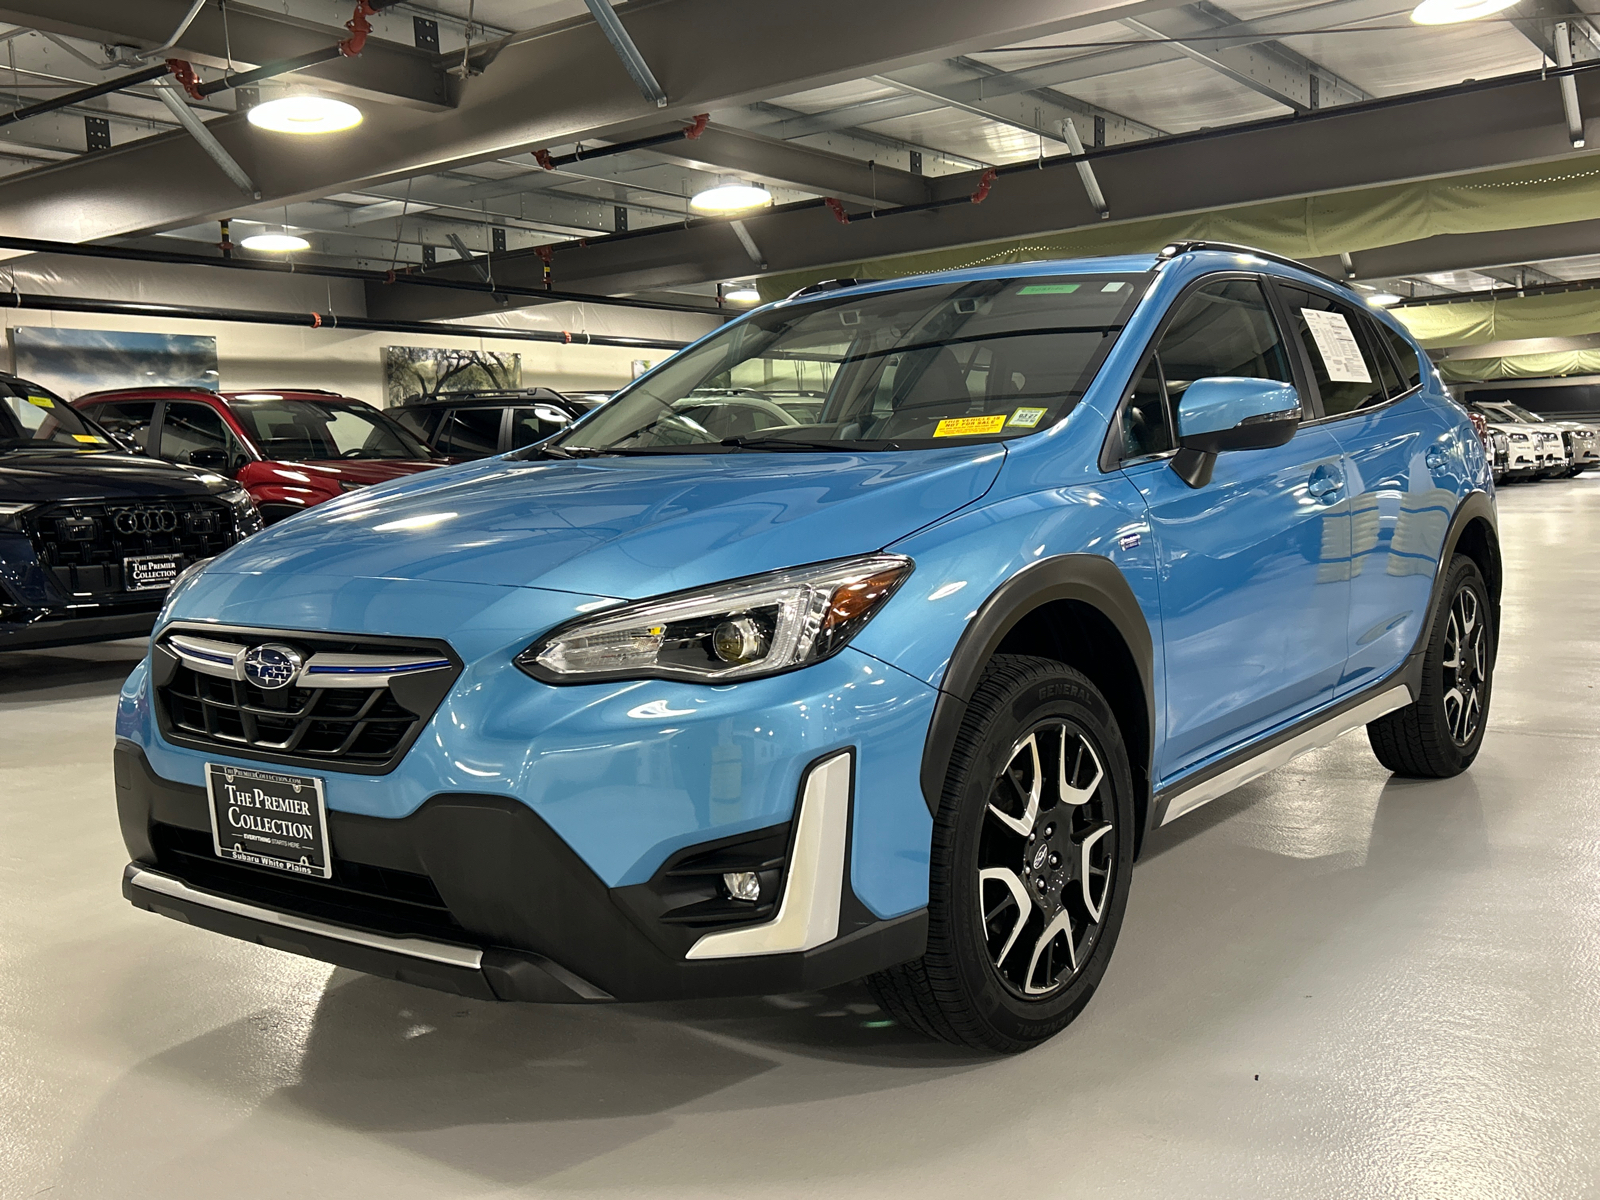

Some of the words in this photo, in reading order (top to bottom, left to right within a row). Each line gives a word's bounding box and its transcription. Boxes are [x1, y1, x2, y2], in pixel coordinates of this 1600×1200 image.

[132, 563, 148, 571] THE
[148, 561, 176, 570] PREMIER
[132, 570, 176, 579] COLLECTION
[1038, 683, 1092, 705] GENERAL
[224, 784, 253, 807] THE
[253, 788, 311, 816] PREMIER
[228, 806, 313, 840] COLLECTION
[243, 833, 272, 844] EVERYTHING
[271, 837, 288, 847] STARTS
[232, 851, 260, 863] Subaru
[261, 857, 284, 869] White
[286, 862, 312, 874] Plains
